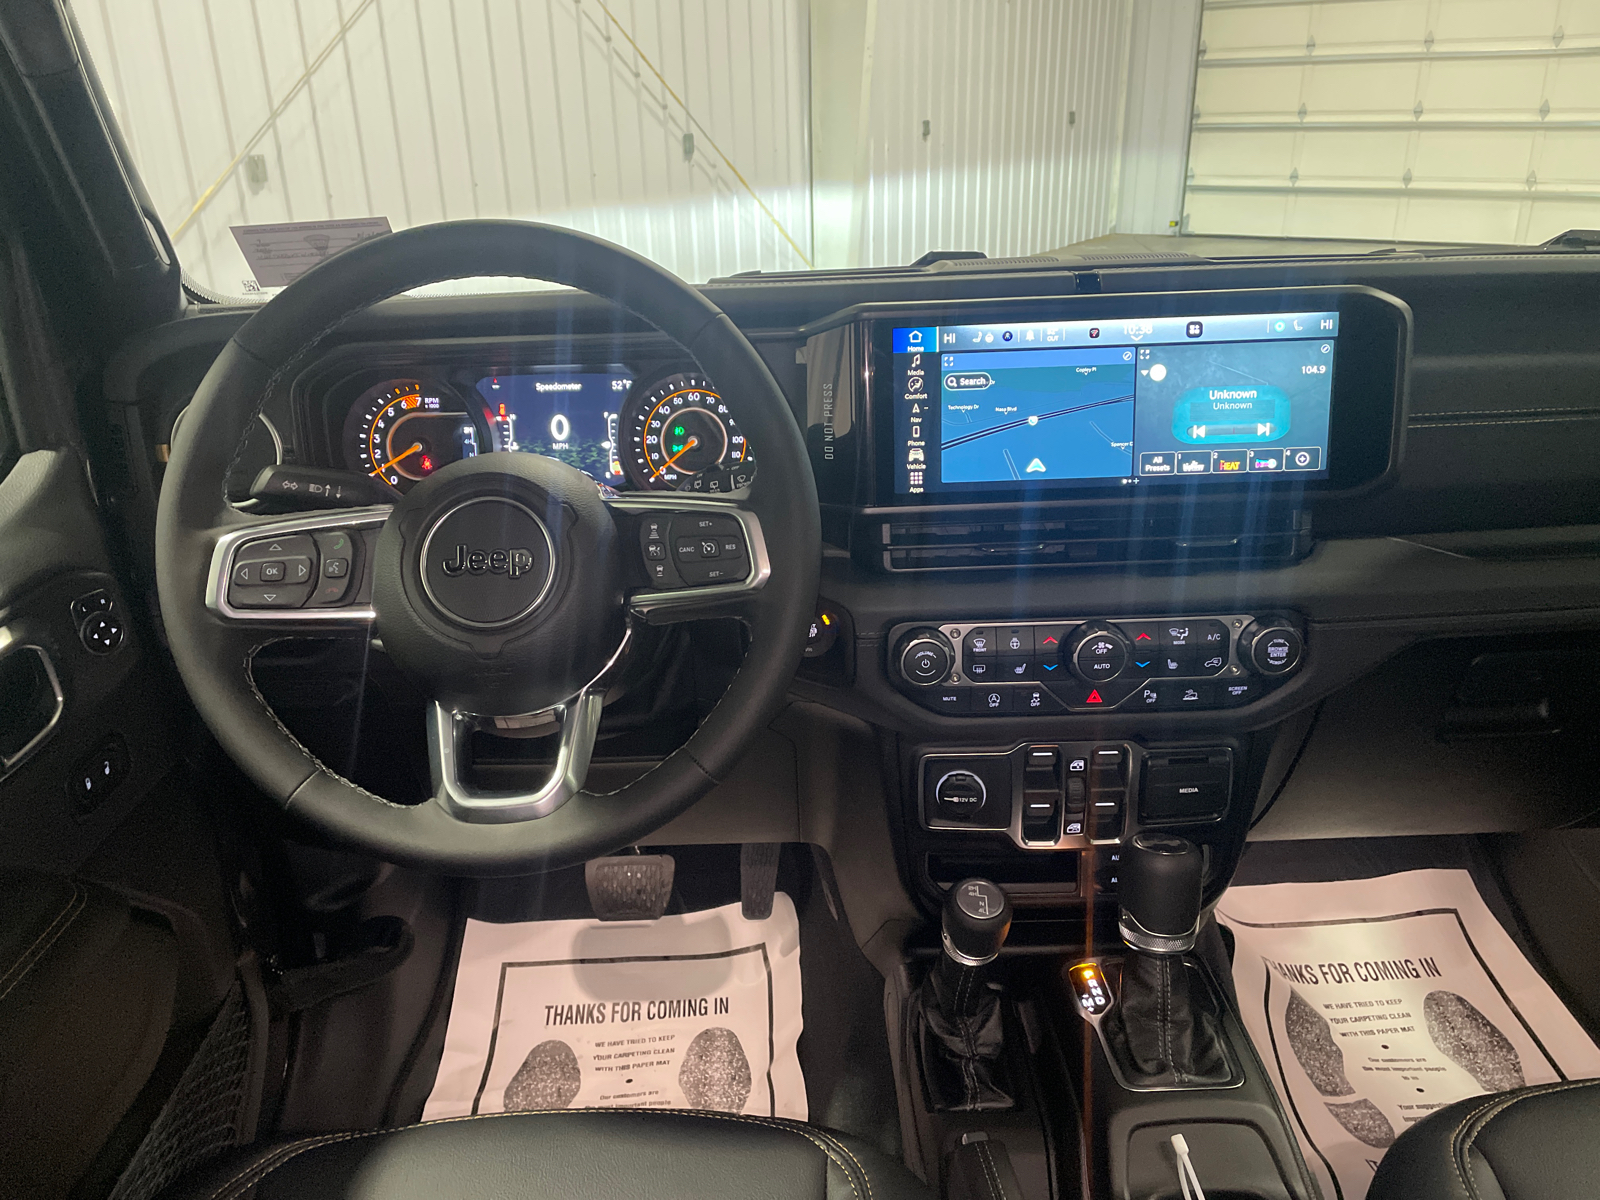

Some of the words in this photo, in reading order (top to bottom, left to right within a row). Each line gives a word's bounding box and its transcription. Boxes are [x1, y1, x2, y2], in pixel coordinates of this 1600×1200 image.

[1320, 319, 1333, 330] HI
[943, 333, 956, 344] HI
[1301, 365, 1326, 375] 104.9
[959, 376, 986, 386] Search
[535, 382, 582, 392] Speedometer
[687, 392, 700, 401] 60
[1209, 389, 1258, 400] Unknown
[401, 400, 407, 409] 6
[414, 397, 421, 408] 7
[673, 397, 683, 405] 50
[706, 396, 715, 404] 70
[823, 383, 833, 417] PRESS
[658, 406, 670, 415] 40
[1213, 402, 1253, 410] Unknown
[387, 407, 395, 417] 5
[378, 419, 385, 429] 4
[550, 414, 570, 441] 0
[823, 421, 834, 442] NOT
[373, 434, 380, 443] 3
[646, 435, 658, 444] 20
[732, 436, 744, 444] 100
[552, 442, 569, 450] MPH
[374, 449, 381, 459] 2
[731, 451, 741, 459] 110
[824, 446, 834, 460] DO
[1152, 456, 1163, 464] All
[1145, 464, 1171, 472] Presets
[1219, 460, 1241, 471] HEAT
[390, 475, 398, 485] 0
[909, 486, 924, 494] Apps
[442, 544, 533, 579] Jeep
[266, 567, 278, 575] OK
[1207, 633, 1221, 641] A/C
[1318, 962, 1355, 985] FOR
[1353, 958, 1422, 982] COMING
[1418, 956, 1443, 978] IN
[1335, 1001, 1354, 1009] HAVE
[1353, 1000, 1375, 1008] TRIED
[1374, 999, 1385, 1007] TO
[1385, 998, 1403, 1006] KEEP
[544, 1002, 606, 1026] THANKS
[611, 1001, 642, 1023] FOR
[647, 998, 708, 1020] COMING
[713, 997, 730, 1015] IN
[1329, 1017, 1349, 1025] YOUR
[1349, 1013, 1389, 1023] CARPETING
[1388, 1011, 1412, 1020] CLEAN
[1359, 1029, 1377, 1037] THIS
[1376, 1026, 1400, 1035] PAPER
[1399, 1025, 1416, 1033] MAT
[606, 1039, 625, 1047] HAVE
[626, 1037, 647, 1046] TRIED
[658, 1034, 676, 1042] KEEP
[613, 1050, 652, 1060] CARPETING
[653, 1047, 676, 1055] CLEAN
[632, 1061, 655, 1070] PAPER
[656, 1059, 671, 1067] MAT
